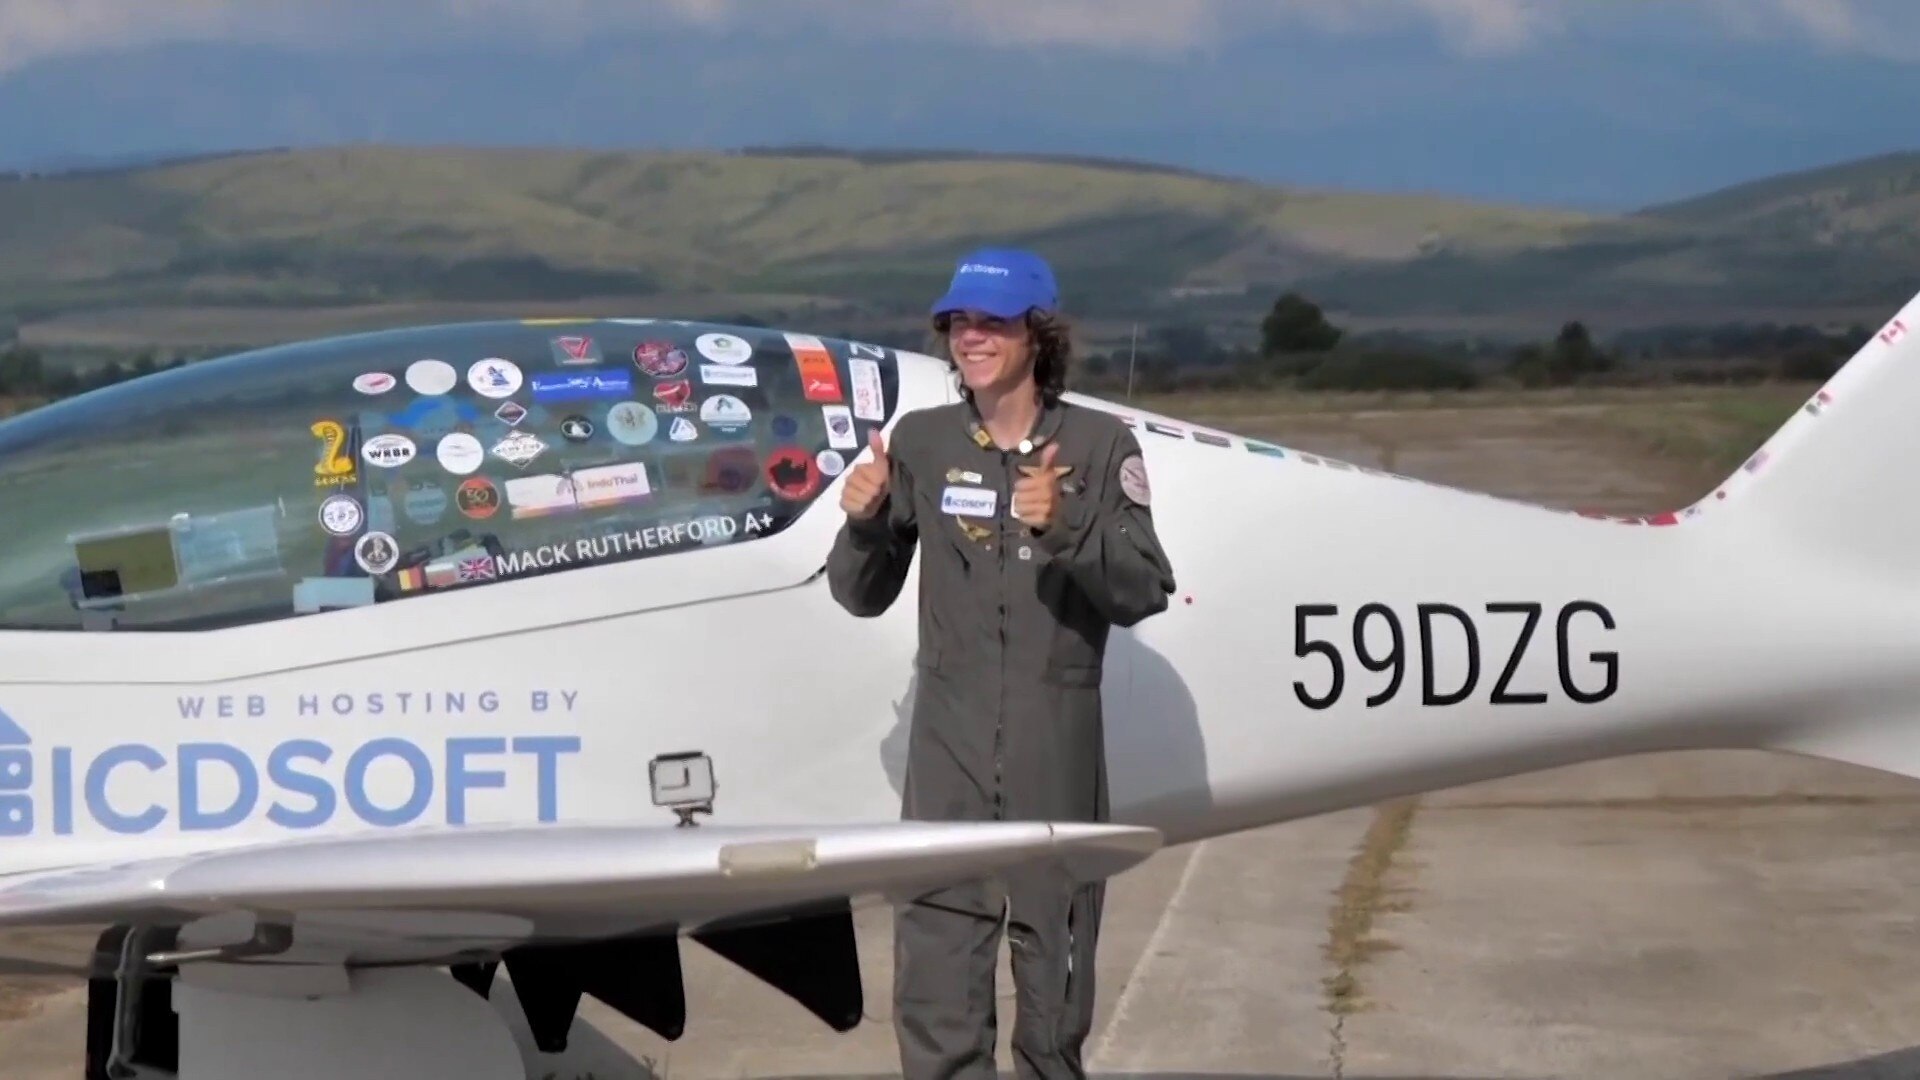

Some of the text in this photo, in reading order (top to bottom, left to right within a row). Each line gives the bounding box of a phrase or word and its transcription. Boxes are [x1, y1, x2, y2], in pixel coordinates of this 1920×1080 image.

[496, 512, 775, 576] MACK RUTHERFORD A+
[1293, 600, 1620, 710] 59DZG
[177, 690, 580, 720] WEB HOSTING BY
[51, 735, 582, 836] ICDSOFT
